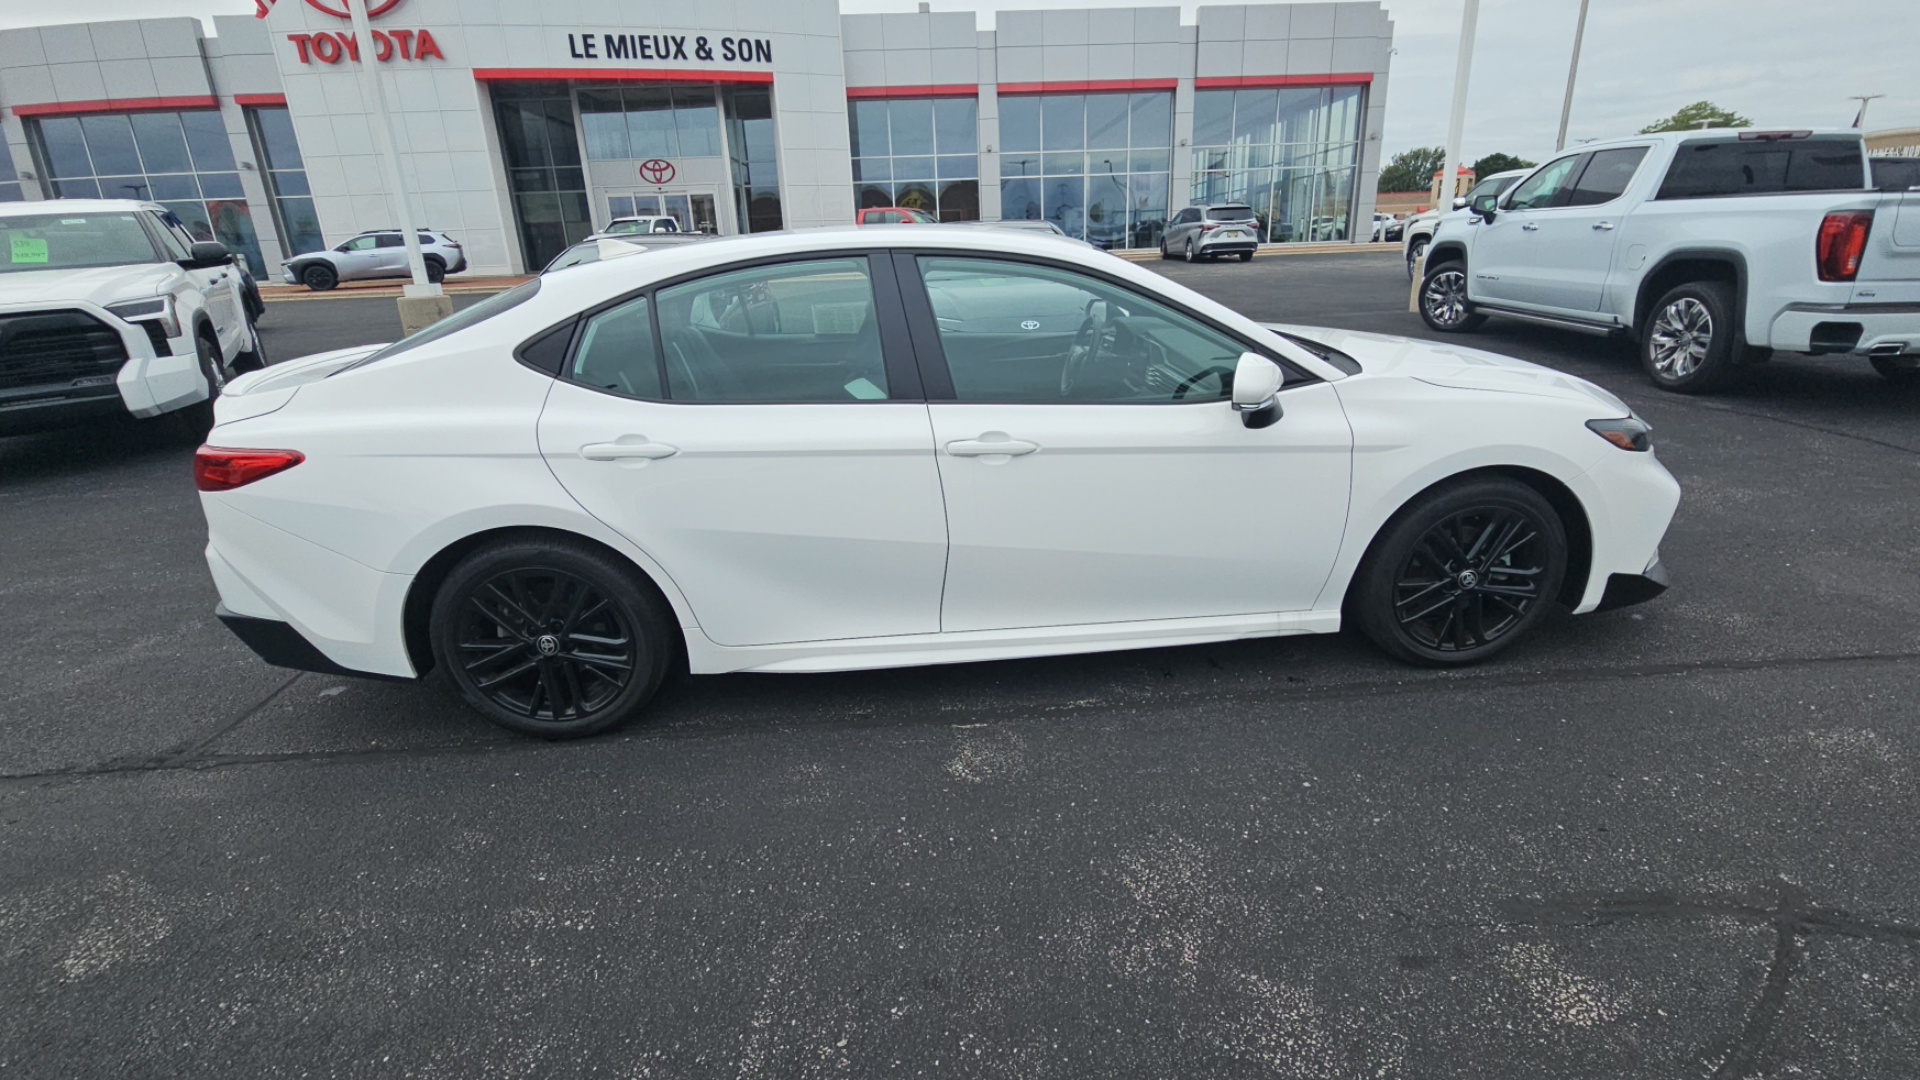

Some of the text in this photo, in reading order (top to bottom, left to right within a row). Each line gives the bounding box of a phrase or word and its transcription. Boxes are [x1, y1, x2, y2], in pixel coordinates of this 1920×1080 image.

[287, 29, 445, 65] TOYOTA
[568, 33, 773, 63] LE MIEUX & SON
